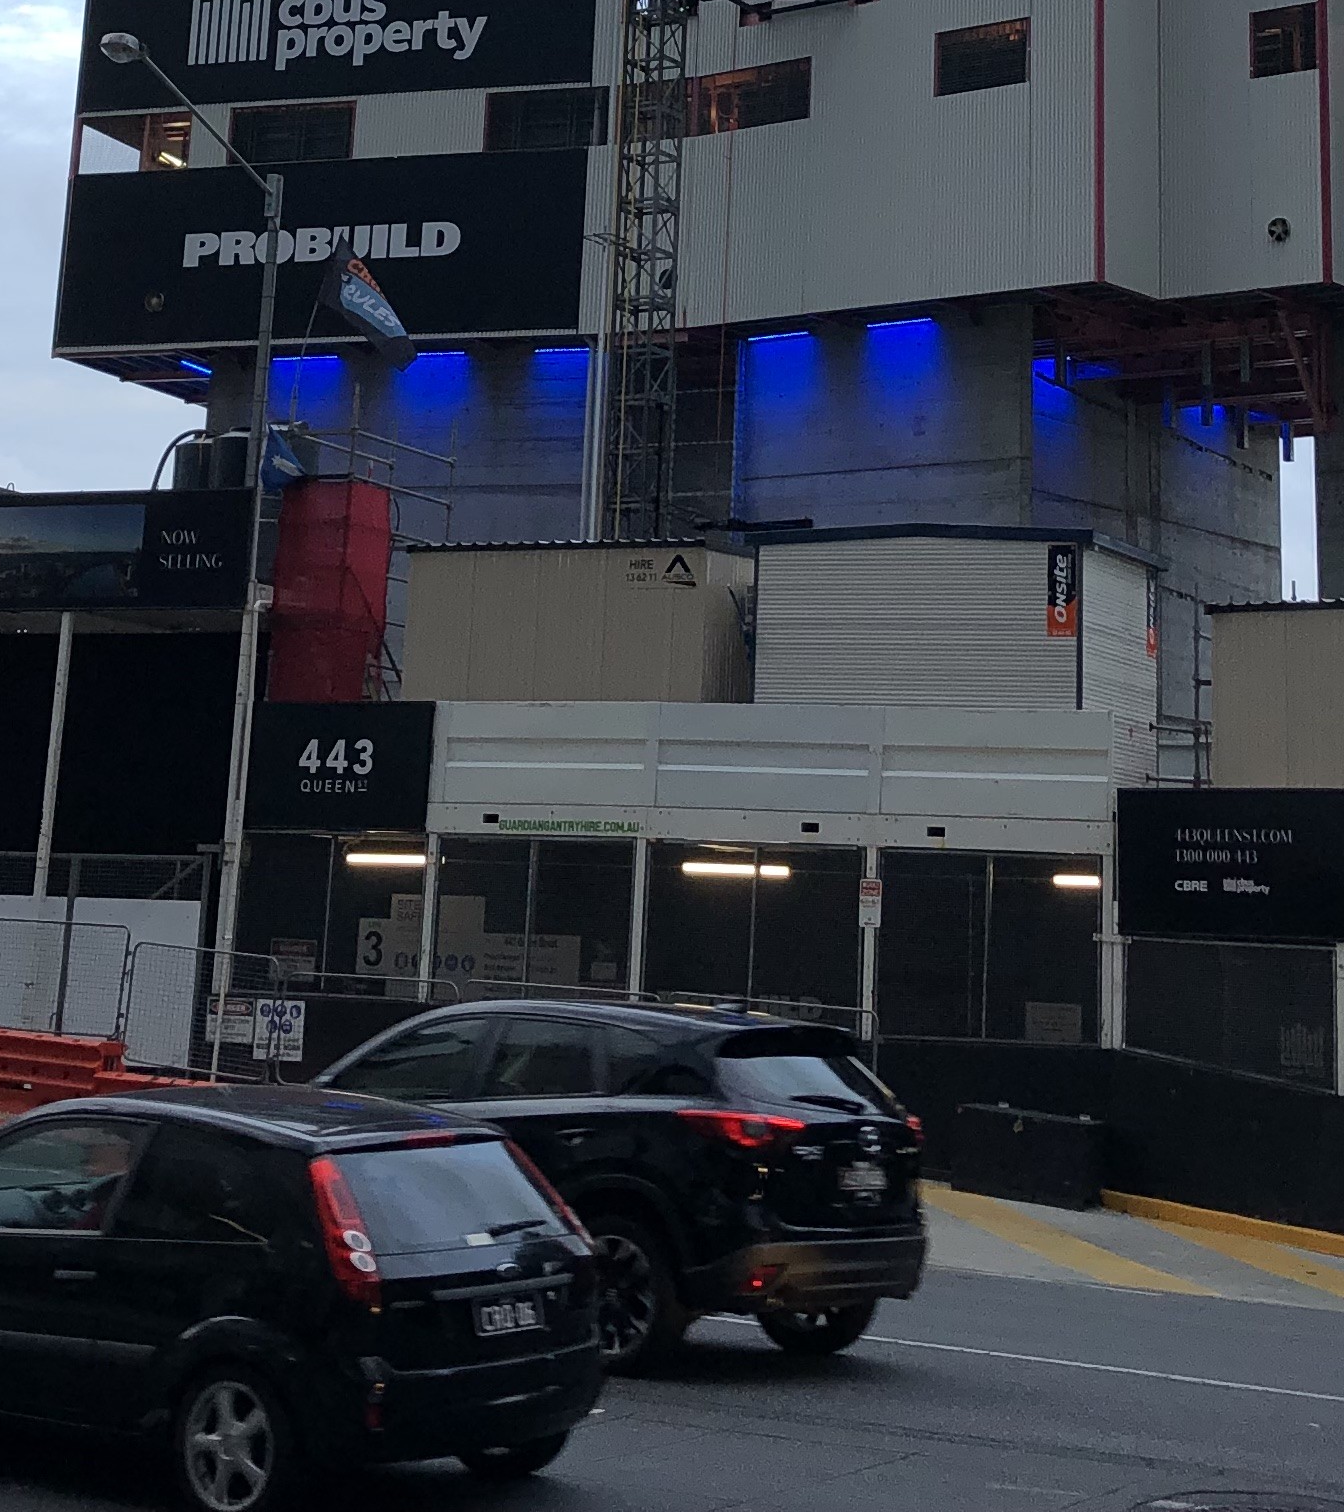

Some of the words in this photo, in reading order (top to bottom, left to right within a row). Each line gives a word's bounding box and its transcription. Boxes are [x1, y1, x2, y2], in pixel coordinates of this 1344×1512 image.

[275, 10, 488, 70] property
[182, 222, 460, 267] PROBUILD
[160, 529, 199, 545] NOW
[159, 553, 223, 569] SELLING
[629, 559, 654, 569] HIRE
[298, 738, 374, 775] 443
[499, 819, 640, 833] GUARDIANGANTRYHIRE.COM.AU
[1176, 849, 1203, 862] 1300
[1206, 849, 1231, 863] 000
[1175, 880, 1208, 891] CBRE
[363, 931, 383, 967] 3
